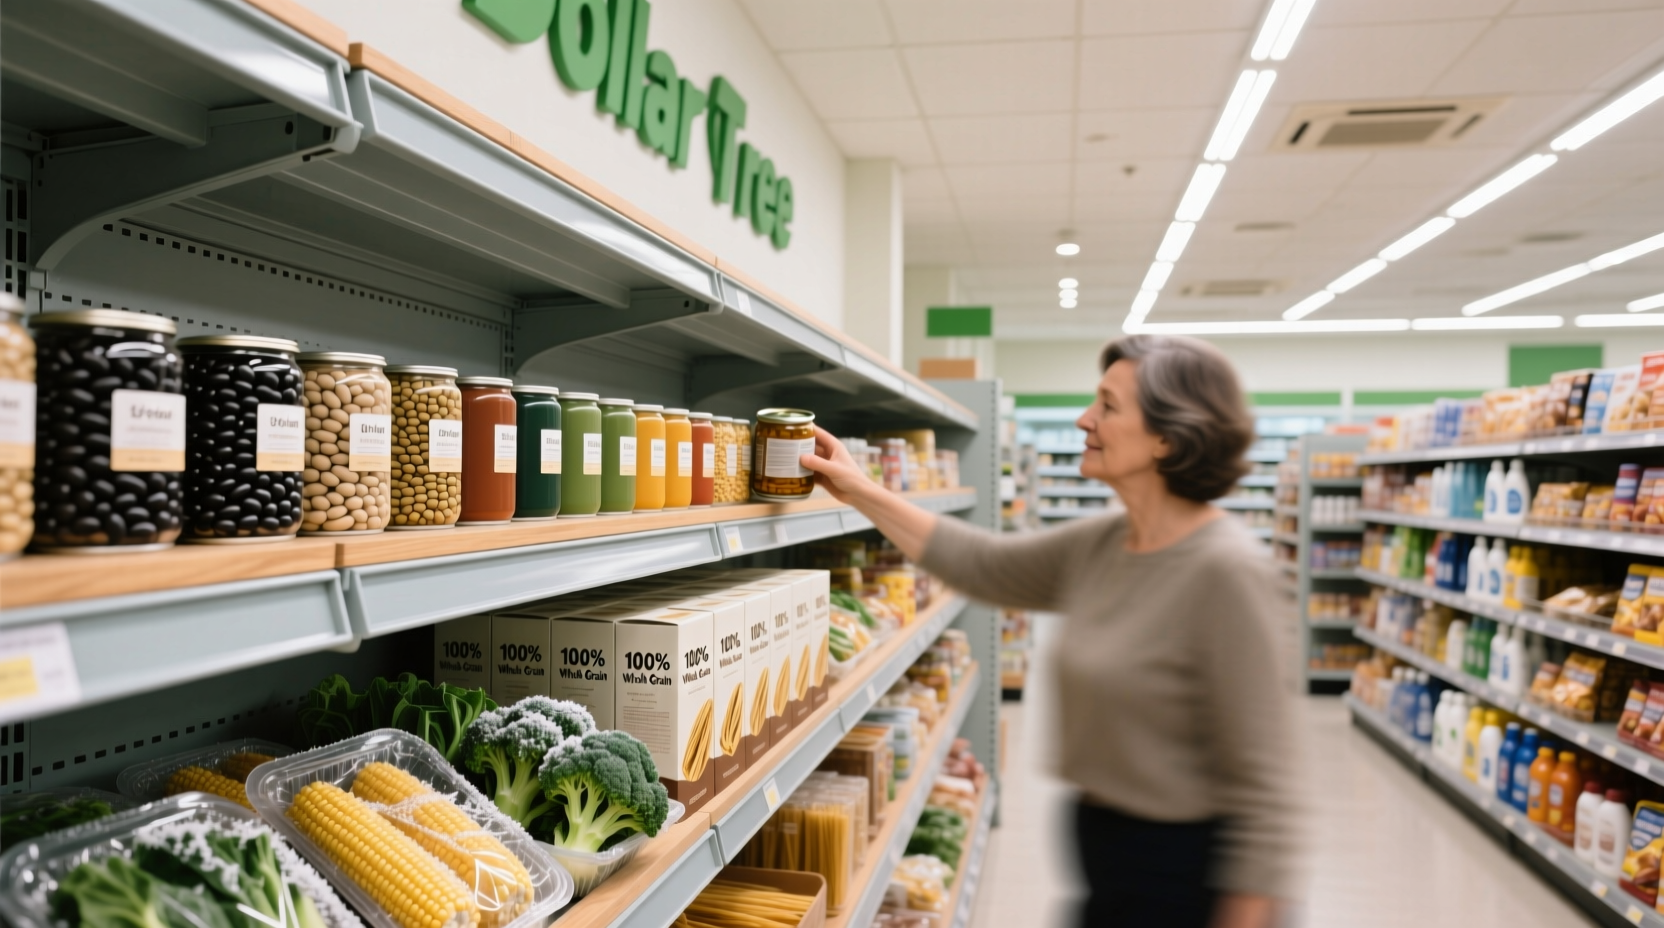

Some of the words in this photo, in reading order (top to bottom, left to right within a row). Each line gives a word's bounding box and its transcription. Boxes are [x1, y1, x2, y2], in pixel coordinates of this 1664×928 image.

[706, 75, 794, 249] Tree
[442, 641, 482, 659] 100%
[499, 643, 542, 662] 100%
[560, 647, 605, 667] 100%
[684, 645, 709, 669] 100%
[624, 651, 671, 671] 100%
